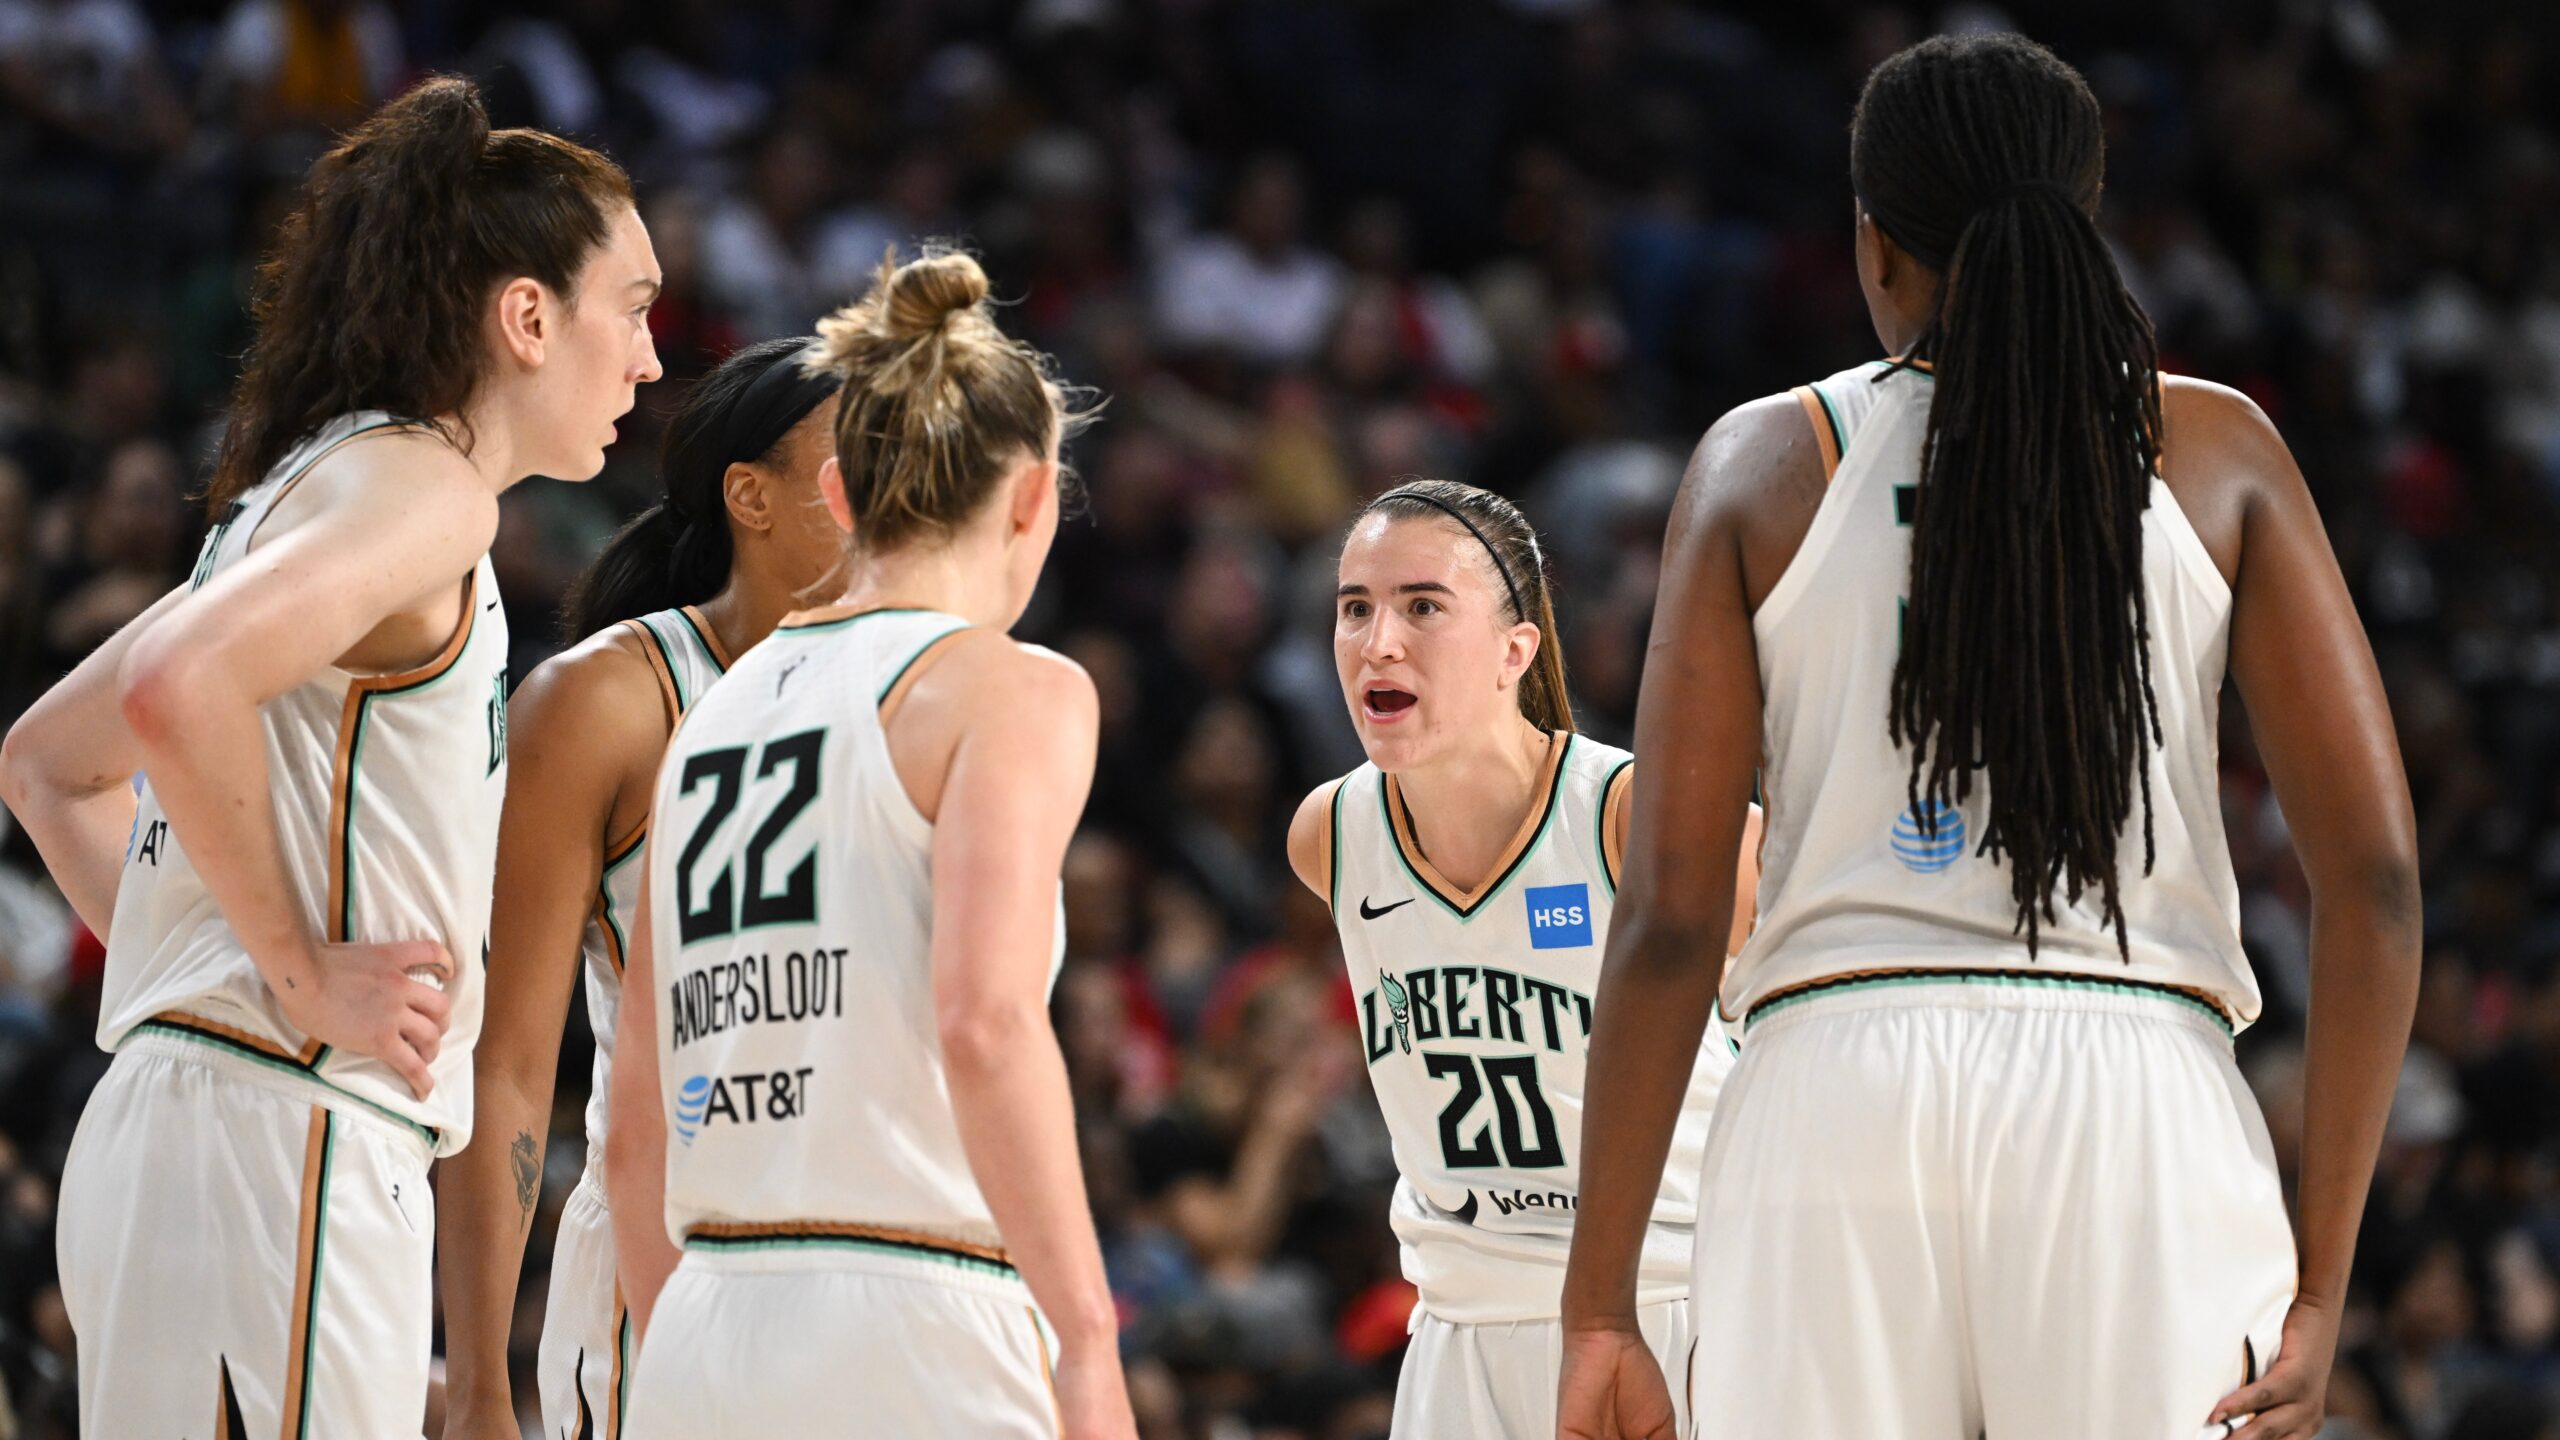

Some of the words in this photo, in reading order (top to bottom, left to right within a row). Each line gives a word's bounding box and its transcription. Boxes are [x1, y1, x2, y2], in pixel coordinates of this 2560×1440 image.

[677, 725, 829, 949] 22
[1533, 905, 1585, 929] HSS
[670, 948, 850, 1053] ANDERSLOOT
[703, 1066, 814, 1128] AT&T
[1420, 1050, 1568, 1171] 20
